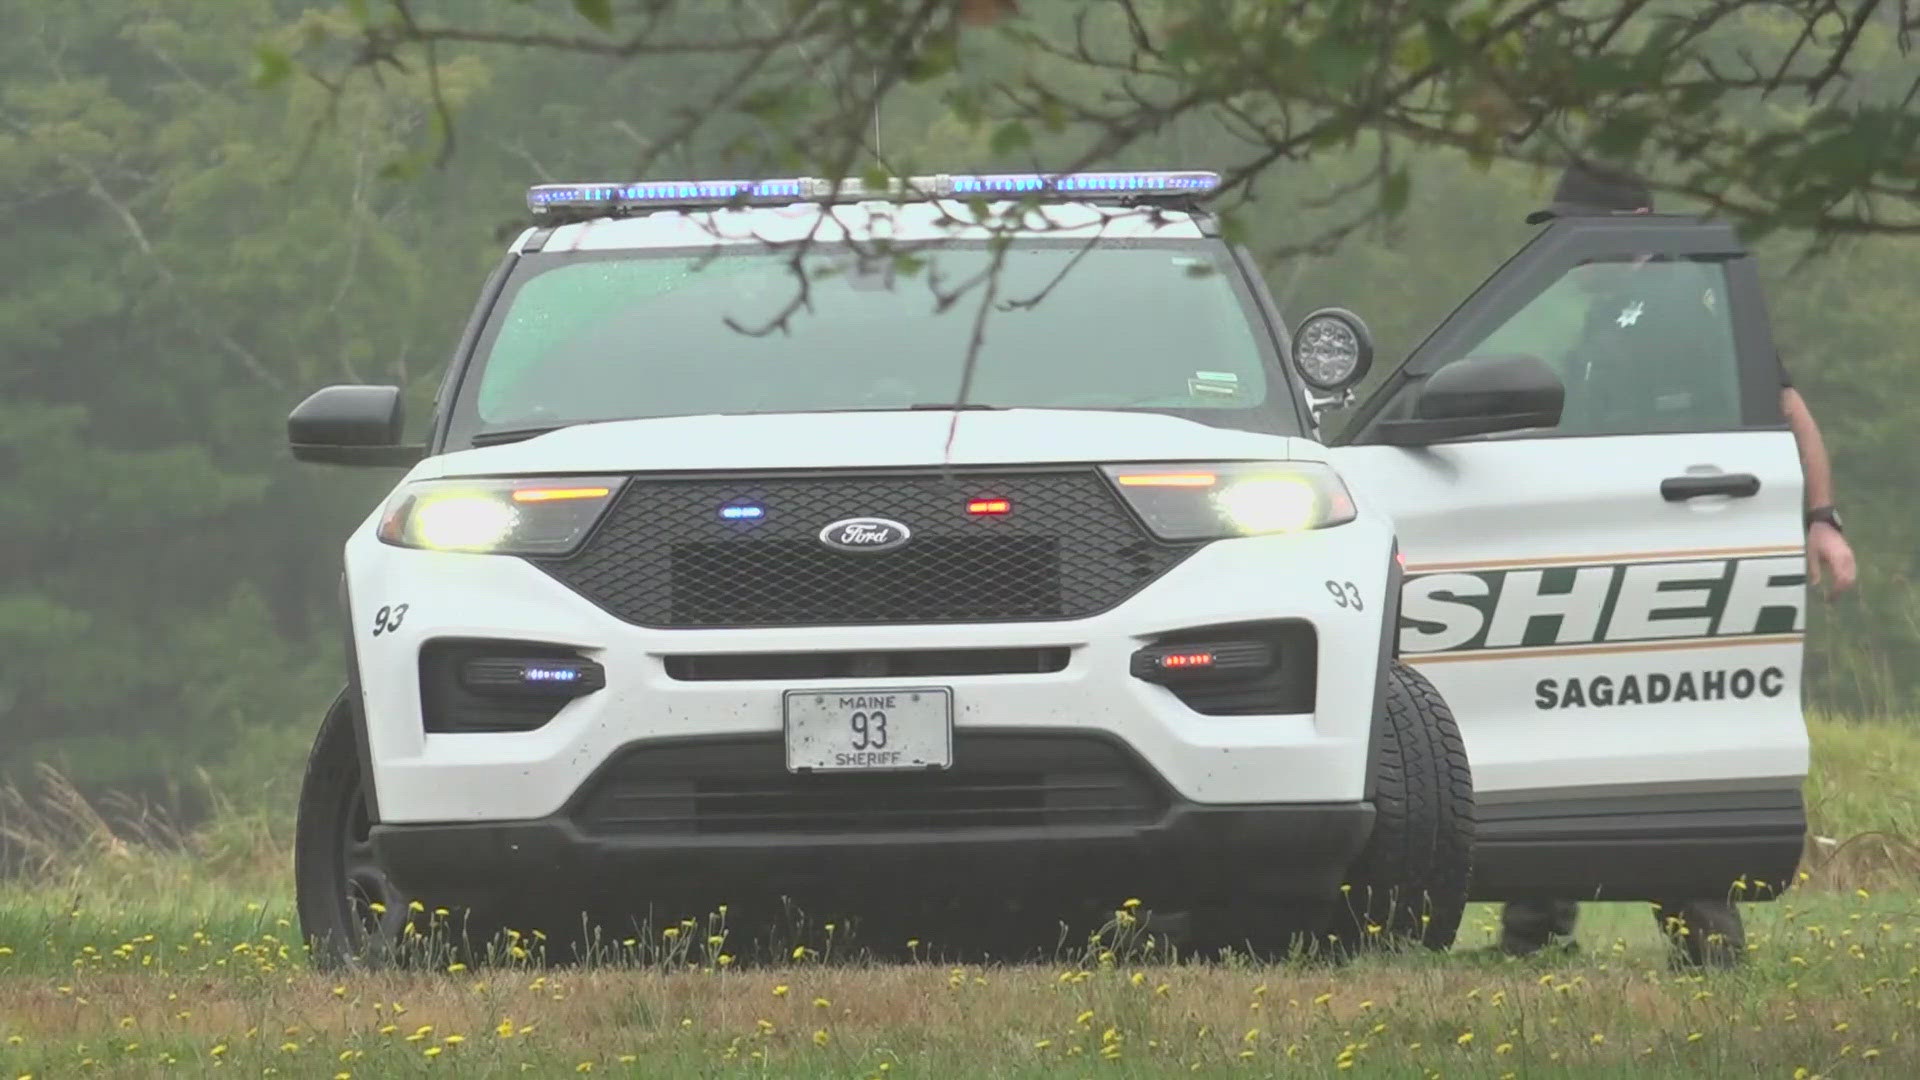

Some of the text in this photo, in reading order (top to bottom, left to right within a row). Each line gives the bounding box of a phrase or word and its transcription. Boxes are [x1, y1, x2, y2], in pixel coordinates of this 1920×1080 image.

[841, 524, 889, 544] Ford
[1325, 580, 1364, 612] 93
[372, 603, 410, 637] 93
[839, 696, 896, 709] MAINE
[1535, 666, 1784, 710] SAGADAHOC
[851, 711, 887, 750] 93
[835, 752, 900, 767] SHERIFF
